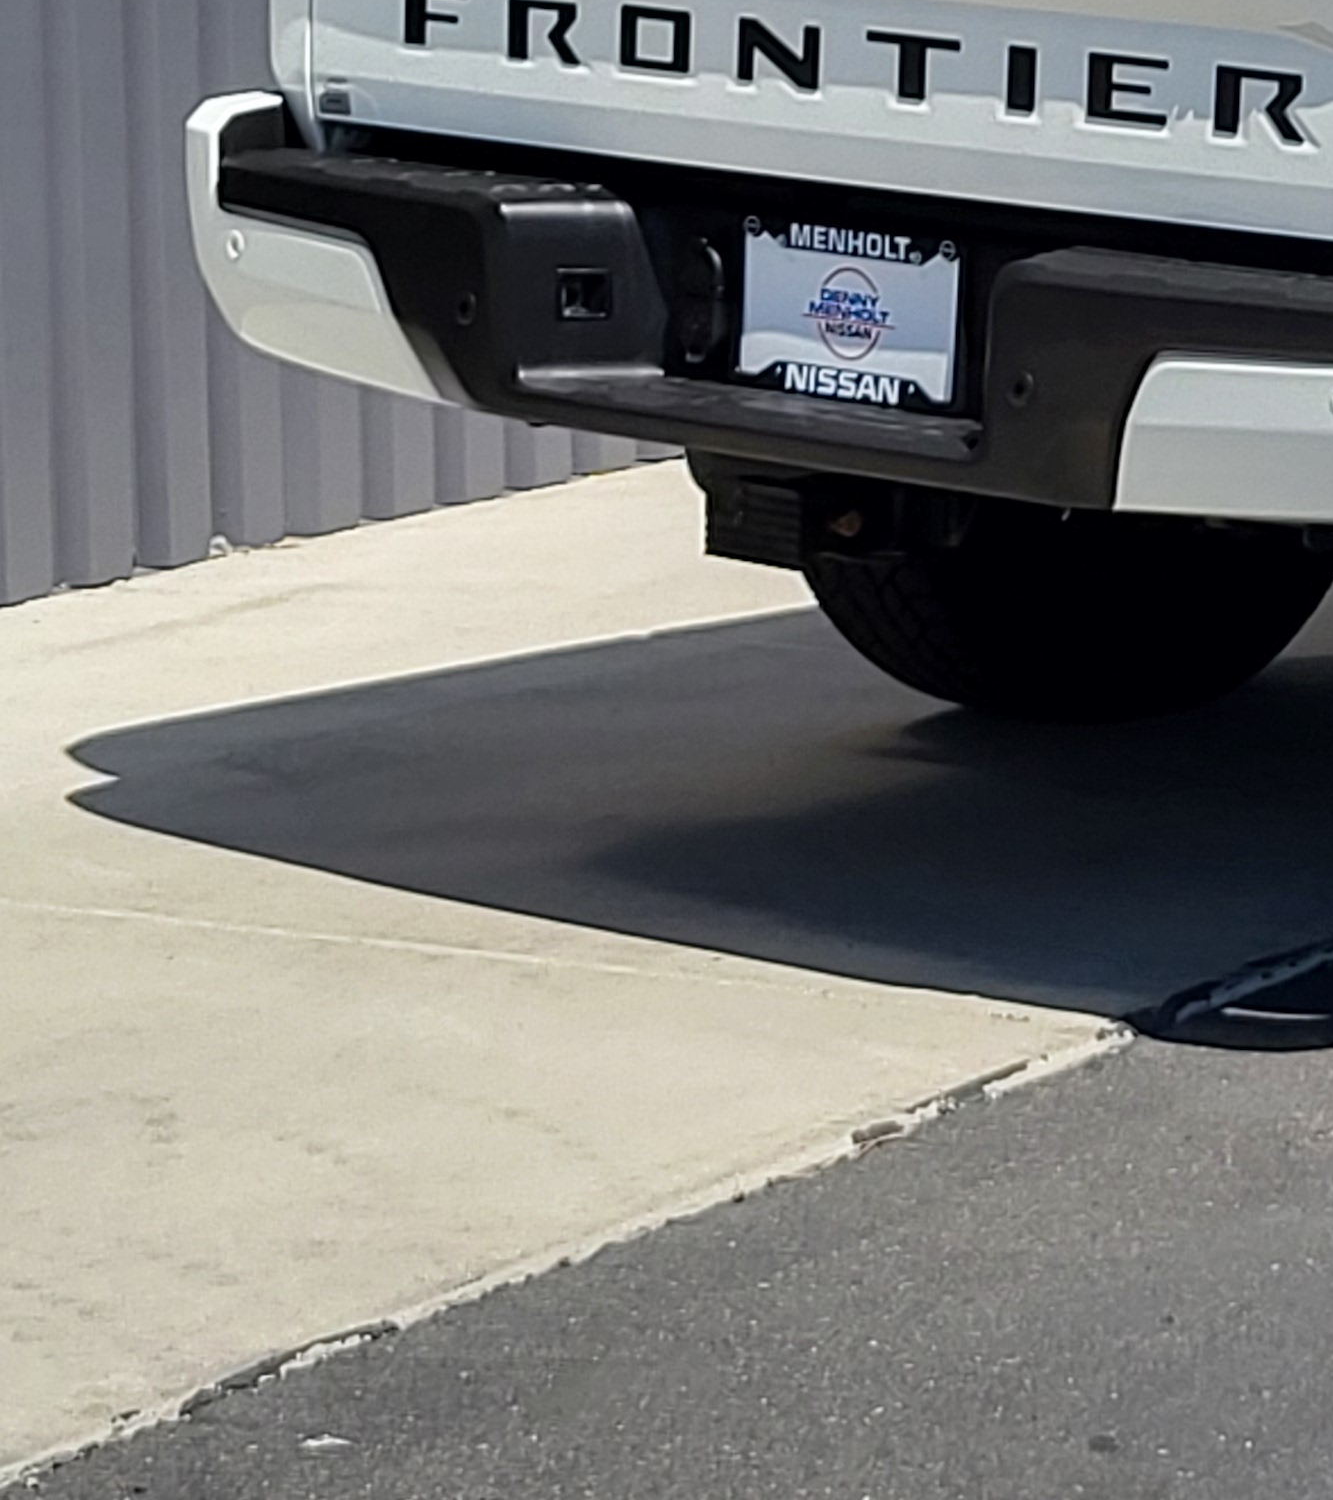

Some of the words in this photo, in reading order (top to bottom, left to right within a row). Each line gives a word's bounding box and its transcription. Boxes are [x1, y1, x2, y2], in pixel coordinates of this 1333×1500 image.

[790, 223, 911, 260] MENHOLT
[820, 288, 880, 308] DENNY
[785, 364, 899, 405] NISSAN
